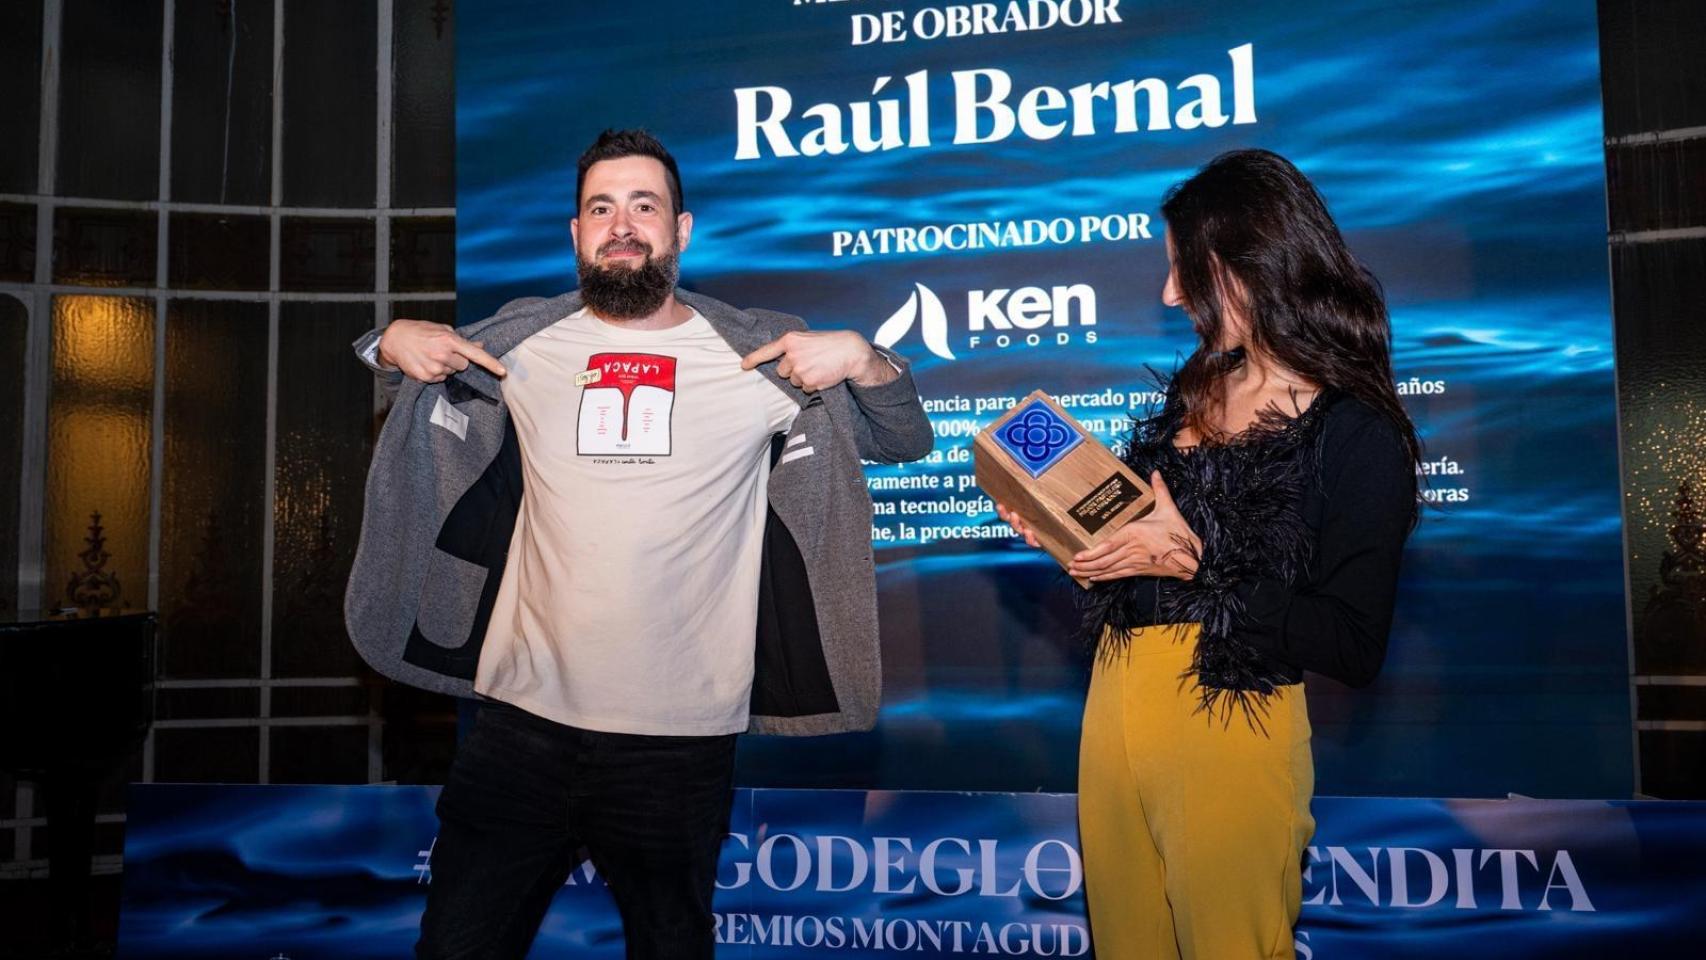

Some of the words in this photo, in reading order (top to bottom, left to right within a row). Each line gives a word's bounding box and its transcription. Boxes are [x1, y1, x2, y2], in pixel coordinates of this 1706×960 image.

[851, 11, 907, 45] DE
[913, 0, 1123, 40] OBRADOR
[734, 69, 931, 160] Raúl
[951, 43, 1257, 145] Bernal
[832, 217, 1077, 256] PATROCINADO
[1080, 213, 1152, 242] POR
[969, 331, 1098, 348] FOODS
[975, 396, 1017, 415] para
[1397, 377, 1446, 395] años
[947, 445, 970, 463] de
[943, 475, 954, 488] a
[900, 495, 994, 517] tecnología
[899, 522, 917, 541] la
